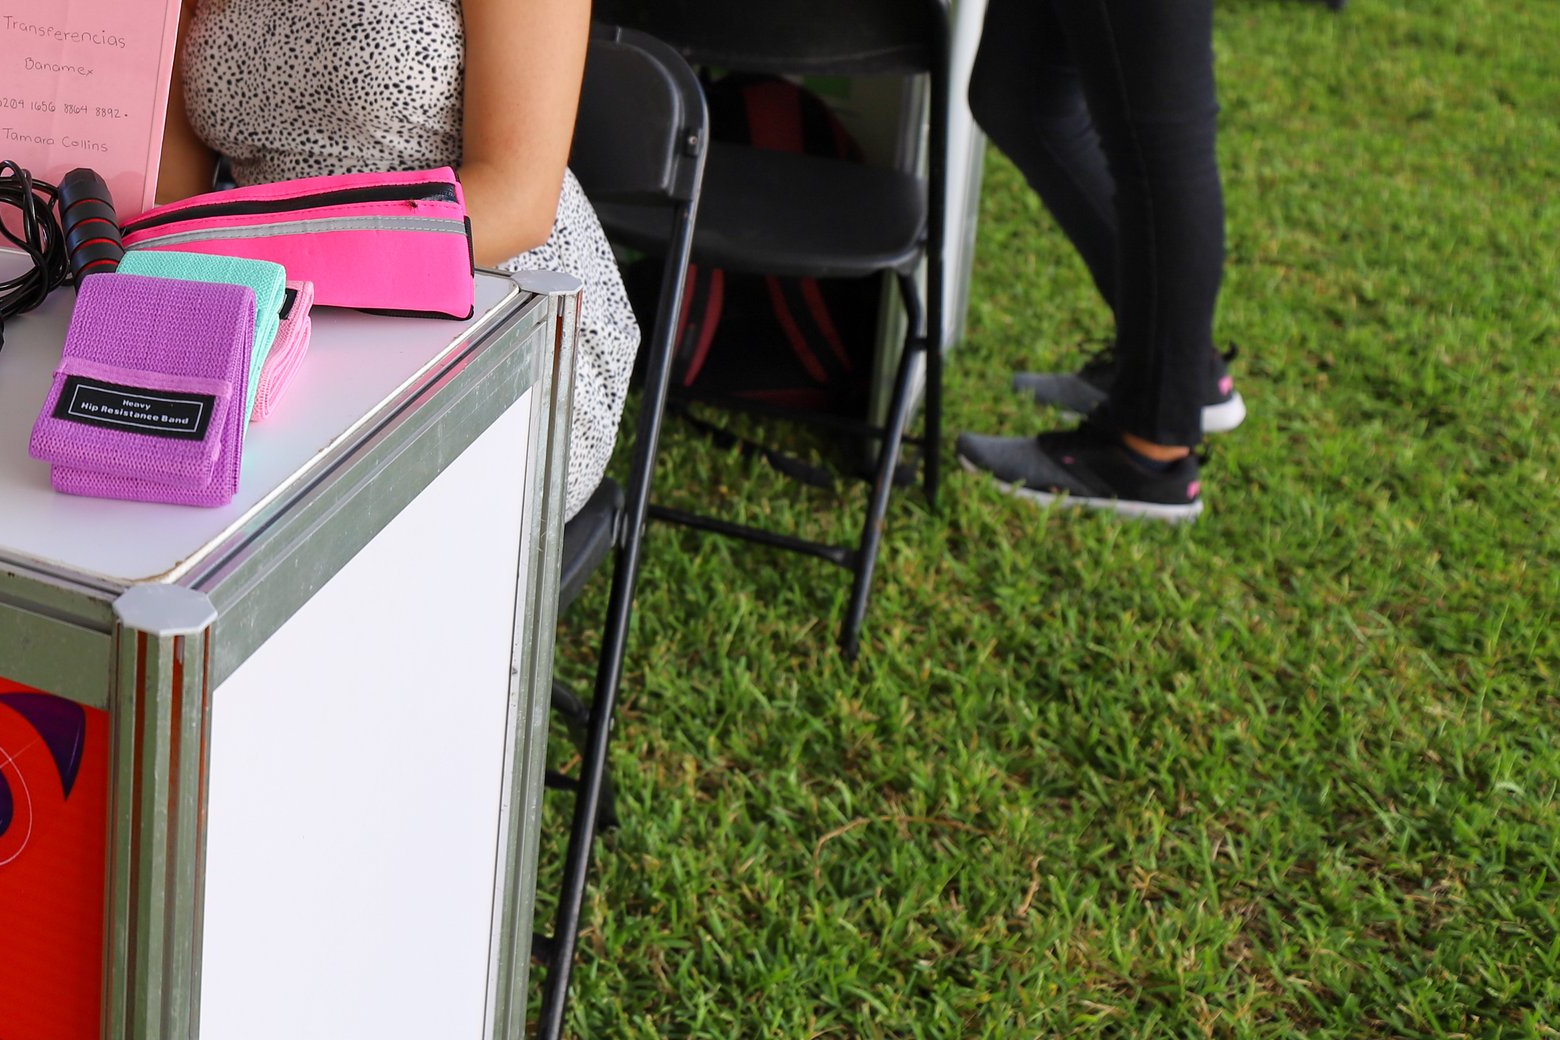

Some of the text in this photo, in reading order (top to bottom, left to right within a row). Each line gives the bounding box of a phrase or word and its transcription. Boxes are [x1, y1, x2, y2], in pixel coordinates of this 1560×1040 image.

[2, 15, 127, 49] Transferencias
[24, 56, 95, 77] Banamex
[30, 101, 56, 113] 1656
[2, 127, 109, 153] Tamara Collins
[81, 401, 189, 425] Hip Resistance Band
[122, 398, 152, 410] Heavy
